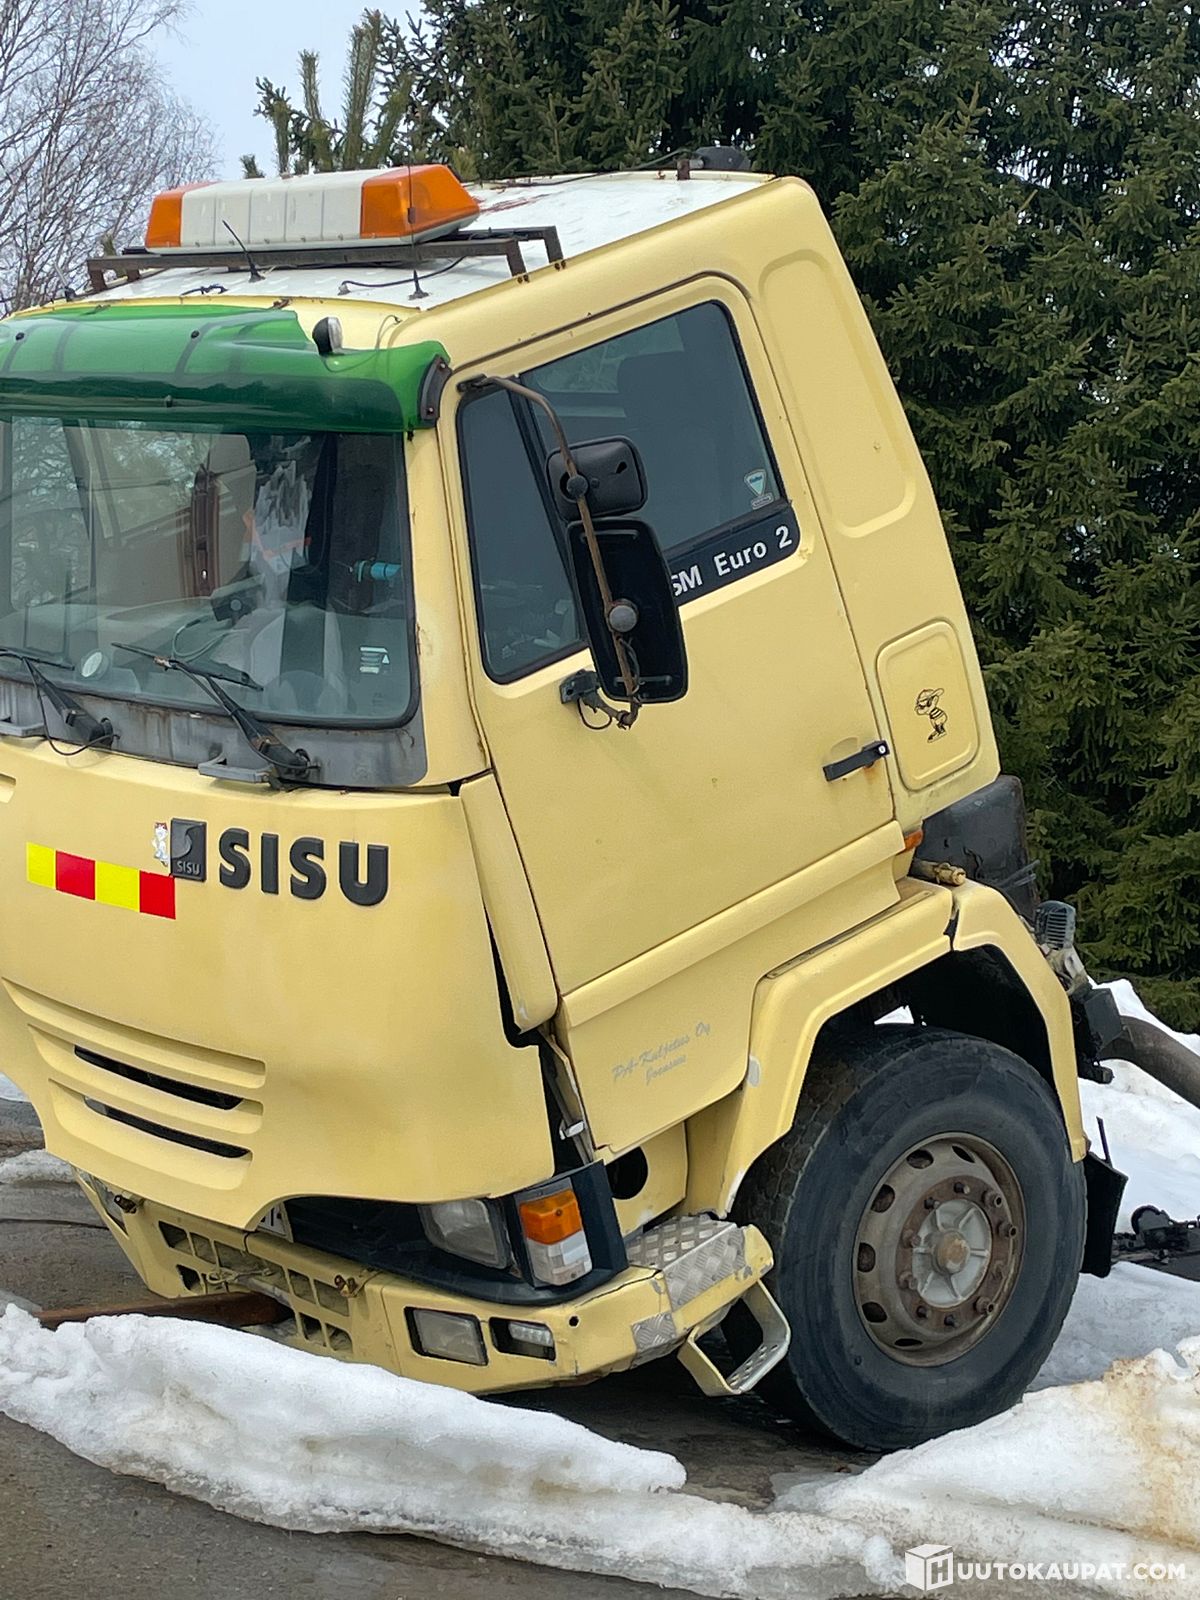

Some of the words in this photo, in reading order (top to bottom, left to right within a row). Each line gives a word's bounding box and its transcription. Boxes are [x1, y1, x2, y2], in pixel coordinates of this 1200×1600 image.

[713, 541, 767, 577] Euro
[775, 525, 793, 549] 2
[176, 860, 200, 876] SISU
[218, 827, 390, 907] SISU
